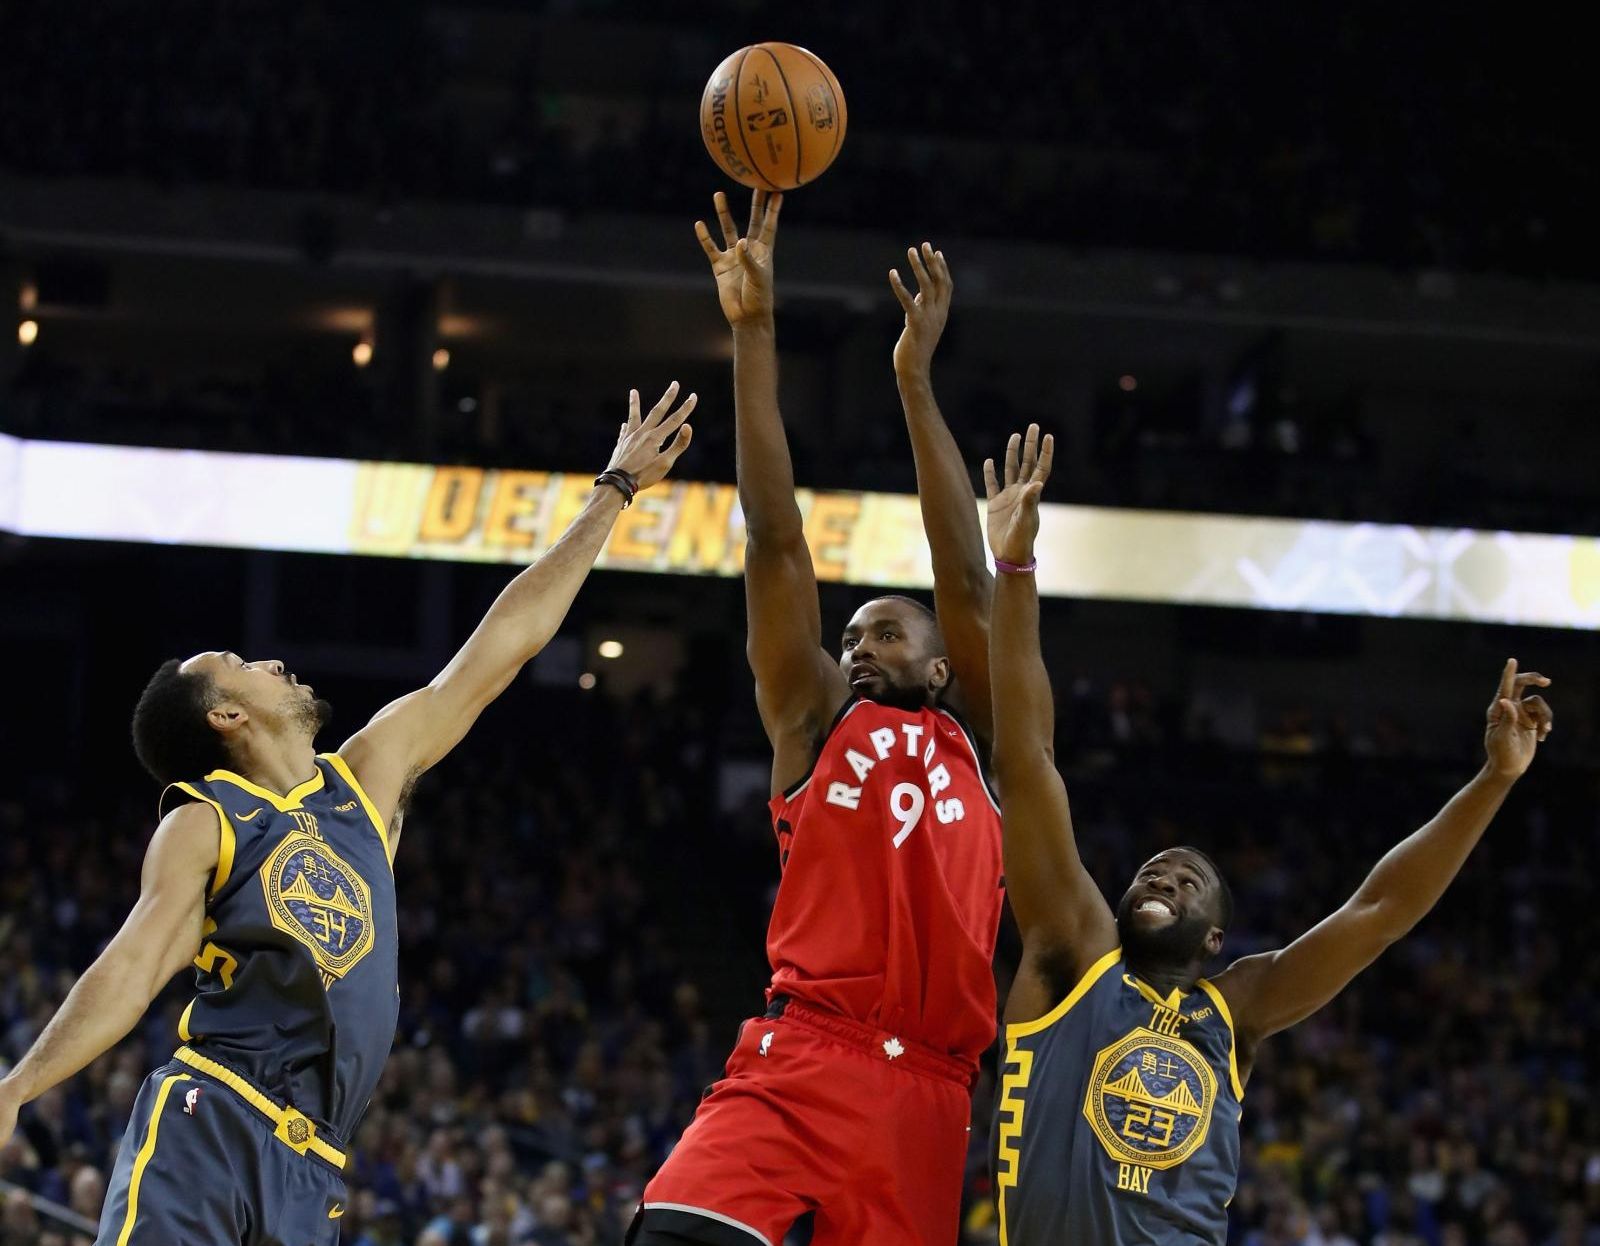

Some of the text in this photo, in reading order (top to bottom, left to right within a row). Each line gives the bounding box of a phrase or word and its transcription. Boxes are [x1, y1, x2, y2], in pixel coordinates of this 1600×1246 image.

[711, 75, 752, 177] SPALDING
[418, 465, 862, 581] DEFENE
[826, 722, 966, 825] RAPTORS
[288, 812, 324, 841] THE
[889, 781, 925, 850] 9
[303, 854, 333, 883] 勇士
[310, 907, 349, 948] 34
[1148, 1002, 1190, 1039] THE
[1141, 1051, 1178, 1080] 勇士
[1123, 1104, 1174, 1147] 23
[1117, 1163, 1153, 1194] BAY
